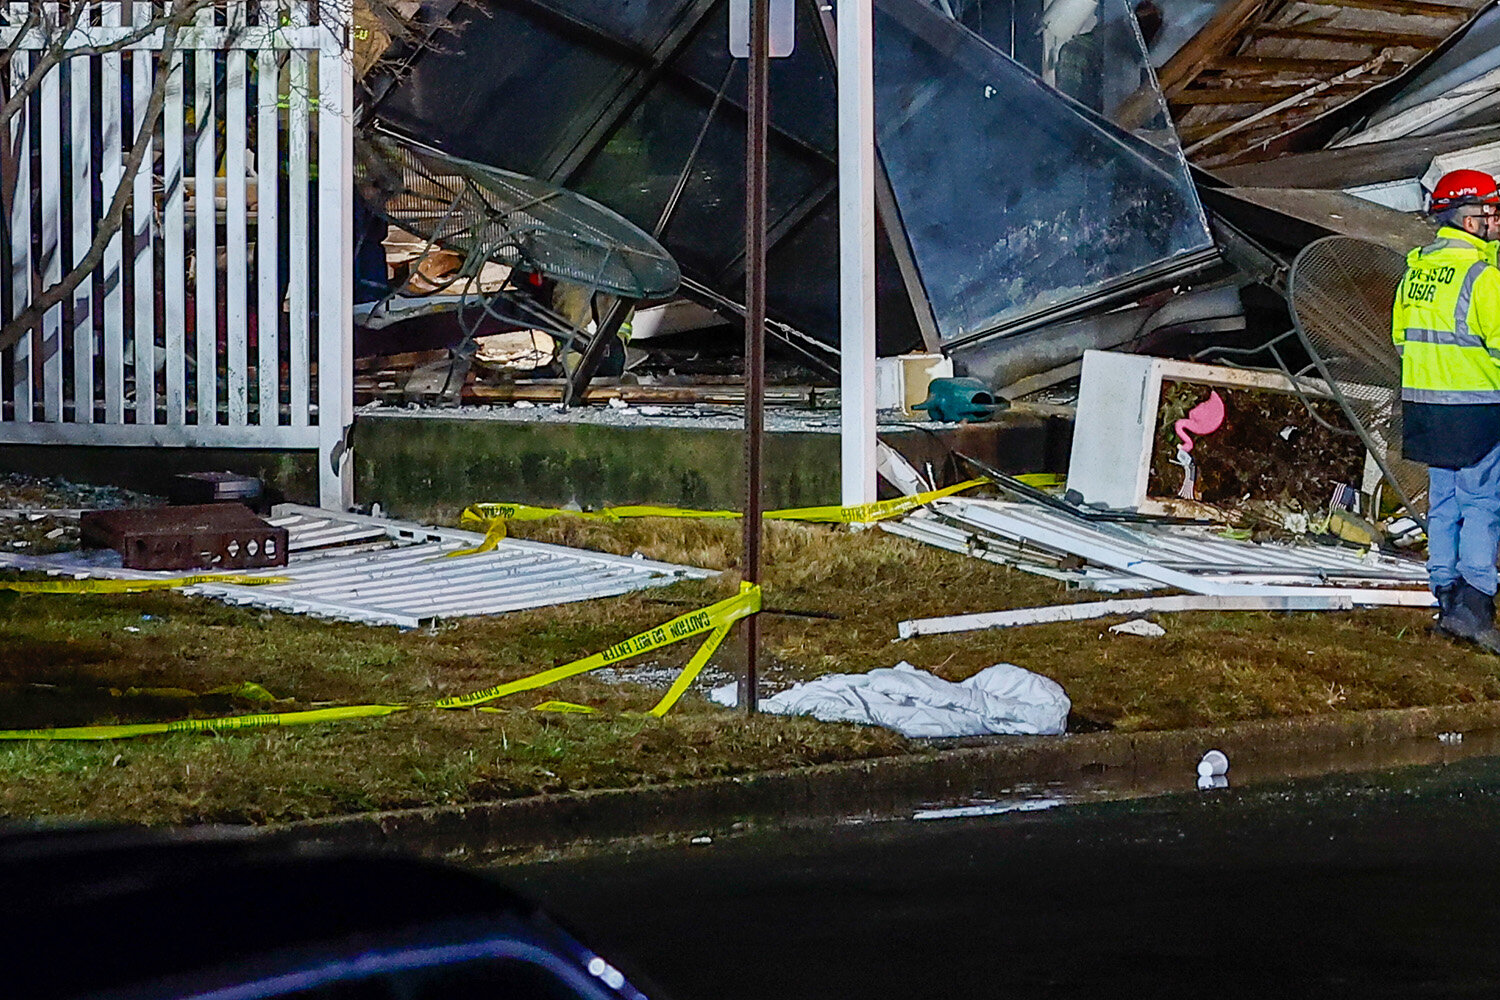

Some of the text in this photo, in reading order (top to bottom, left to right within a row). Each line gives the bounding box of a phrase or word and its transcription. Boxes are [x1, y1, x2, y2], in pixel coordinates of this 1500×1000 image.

[670, 611, 711, 638] CAUTION
[652, 627, 667, 644] DO
[601, 642, 633, 660] ENTER
